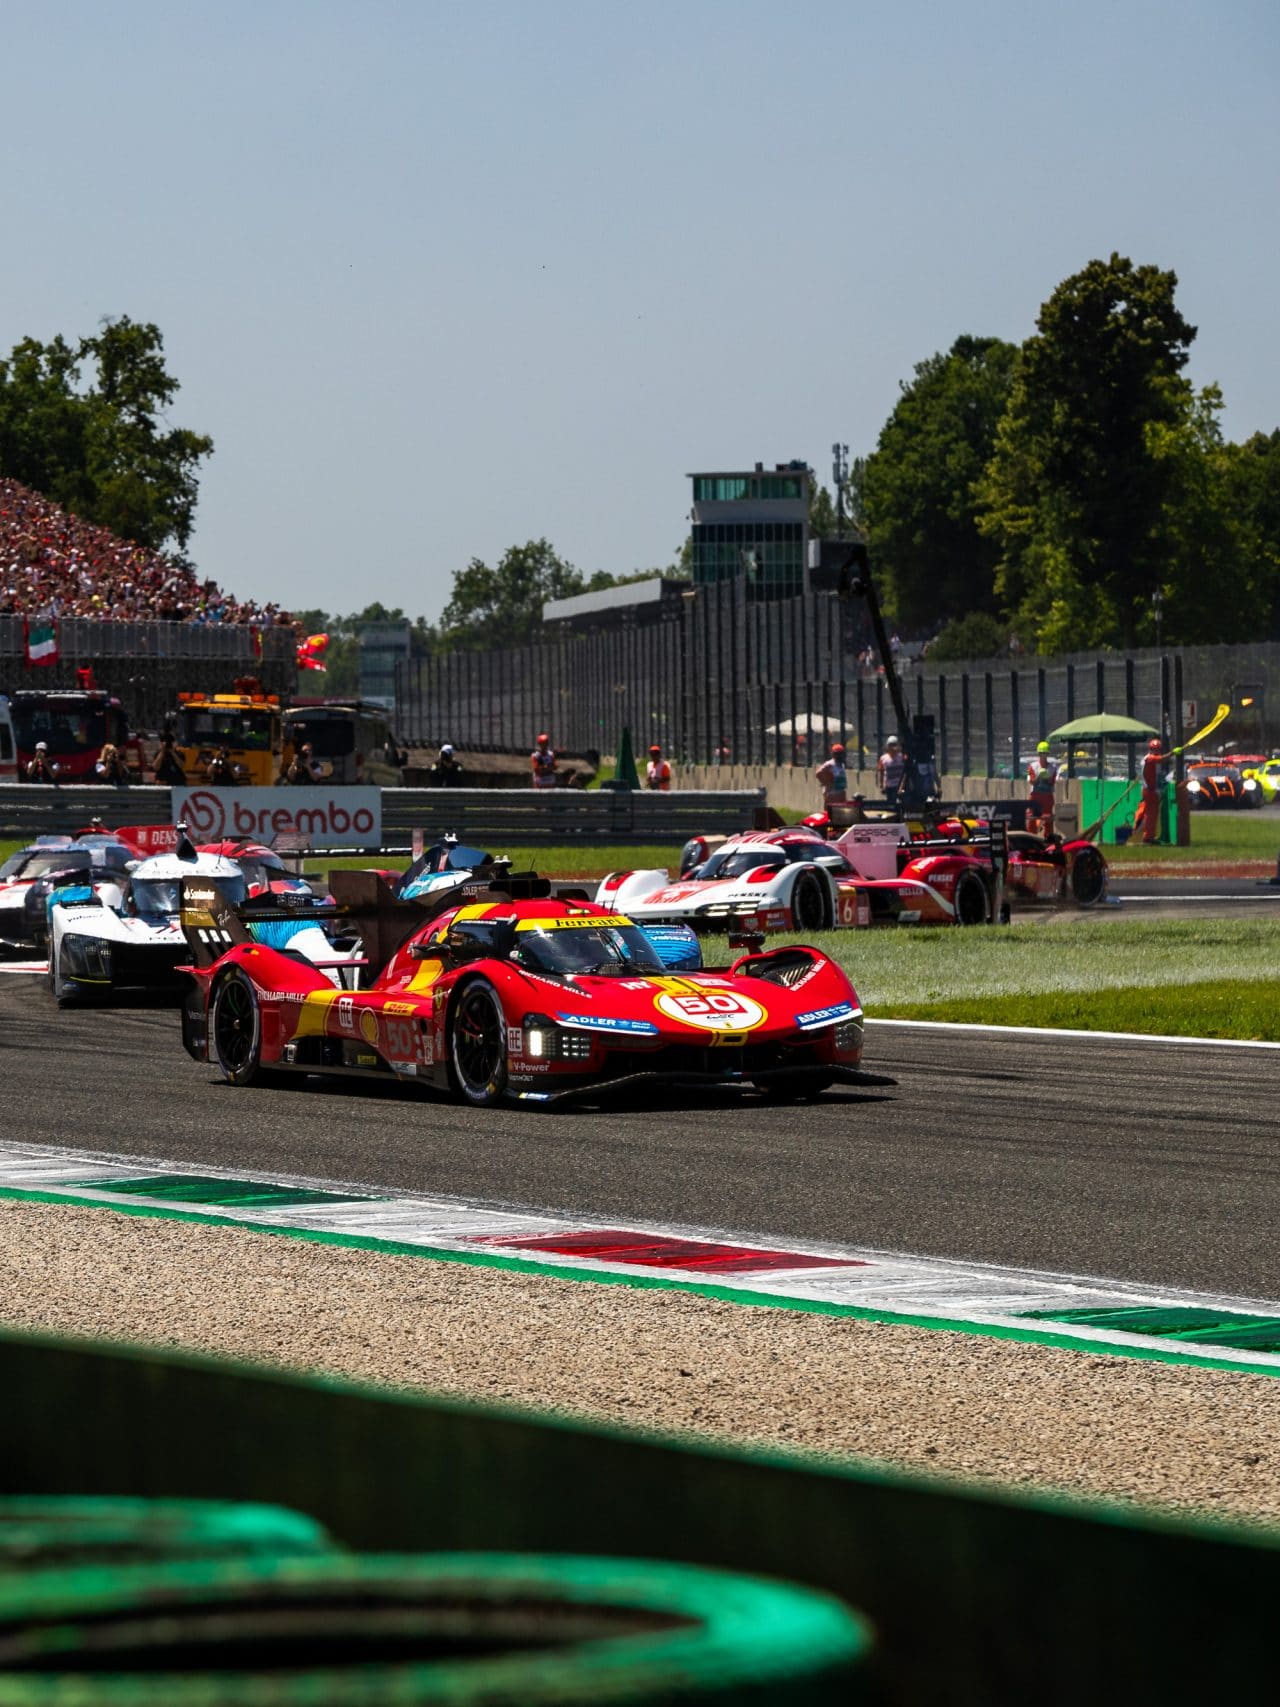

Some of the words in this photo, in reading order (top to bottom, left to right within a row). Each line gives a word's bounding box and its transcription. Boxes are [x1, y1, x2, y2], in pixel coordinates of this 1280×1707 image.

[233, 801, 374, 836] brembo
[853, 829, 900, 837] PORSCHE
[190, 889, 216, 900] Santander
[843, 898, 853, 922] 6
[555, 917, 623, 928] Ferrari
[518, 969, 561, 988] RICHARD
[563, 985, 592, 999] MILLE
[619, 981, 652, 991] HY
[257, 990, 285, 1001] RICHARD
[286, 992, 305, 1002] MILLE
[680, 995, 740, 1013] 50
[566, 1015, 616, 1026] ADLER
[797, 1009, 833, 1024] ADLER
[386, 1022, 411, 1056] 50
[513, 1062, 550, 1072] V-Power
